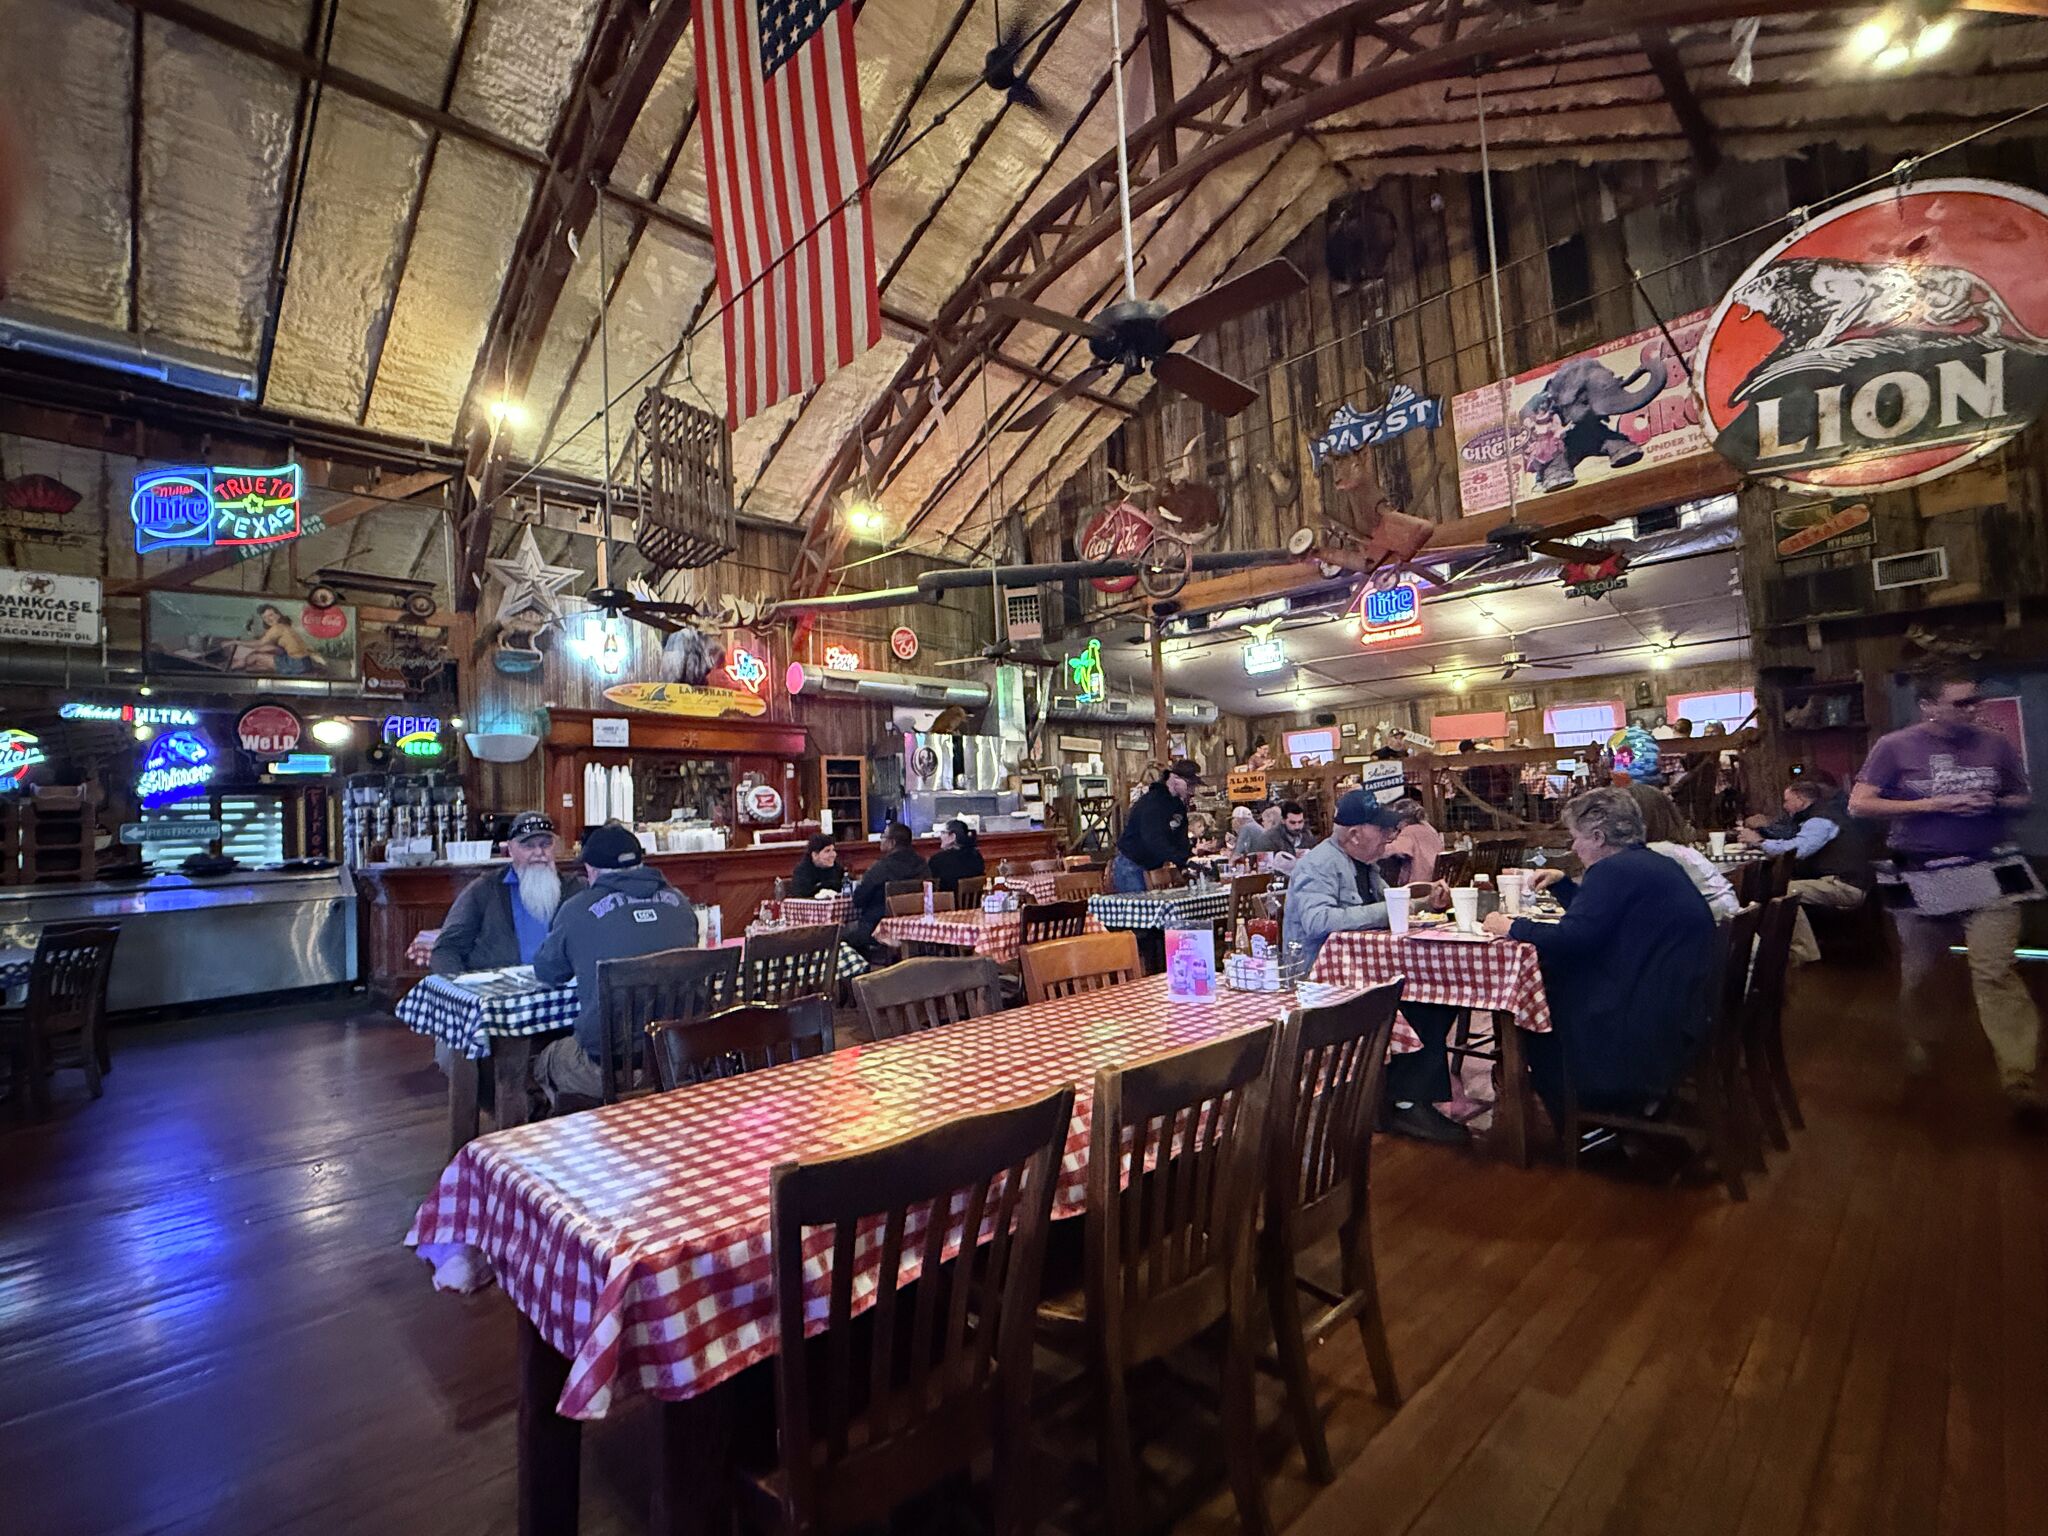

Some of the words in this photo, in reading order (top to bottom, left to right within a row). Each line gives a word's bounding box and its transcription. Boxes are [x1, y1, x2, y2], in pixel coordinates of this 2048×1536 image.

[1756, 350, 2008, 460] LION
[1319, 399, 1432, 458] PABST
[1646, 436, 1685, 453] UNDER
[214, 476, 267, 500] TRUE
[269, 478, 294, 499] TO
[139, 494, 208, 530] Lite
[216, 505, 294, 539] TEXAS
[1590, 579, 1624, 593] EQUIS
[1366, 588, 1413, 623] Lite
[0, 627, 29, 637] ACO
[31, 629, 72, 640] MOTOR
[74, 632, 93, 641] OIL
[678, 685, 734, 699] LANDSHARK
[134, 706, 198, 725] ULTRA
[382, 714, 441, 745] ABITA
[242, 734, 271, 751] We
[1229, 774, 1265, 785] ALAMO
[148, 825, 219, 838] RESTROOMS
